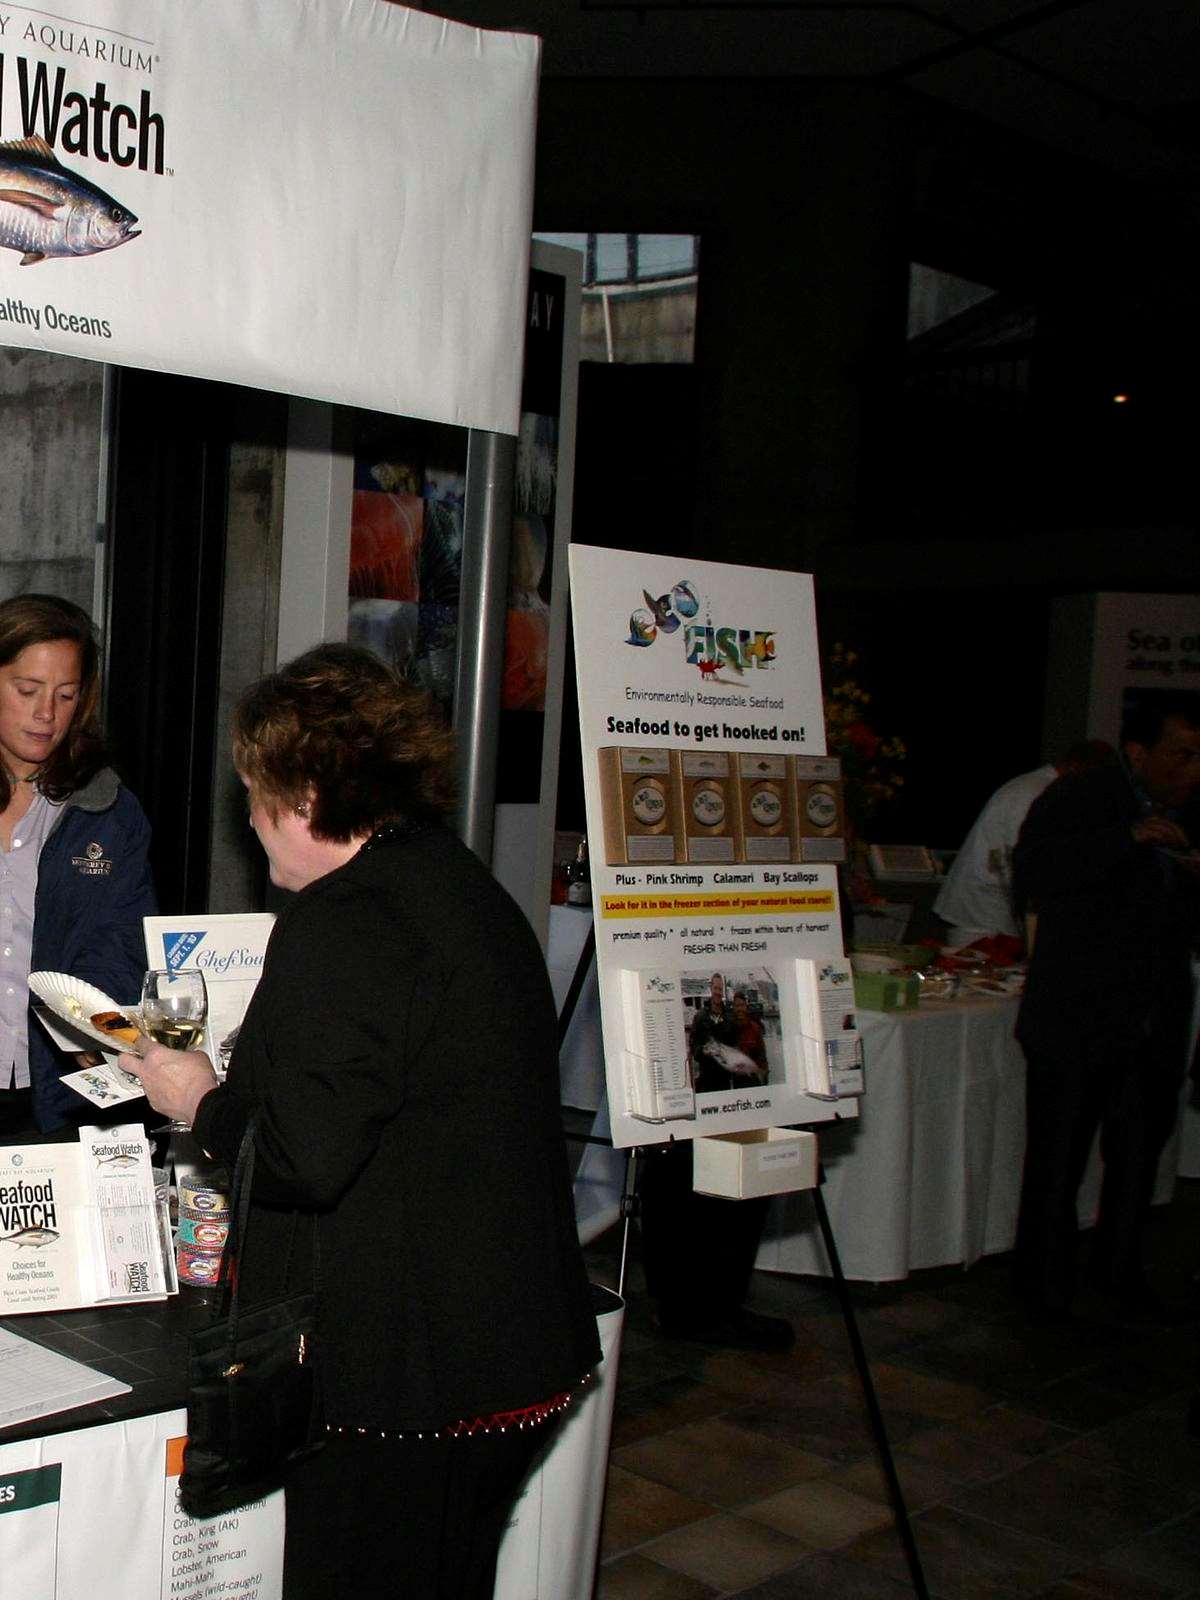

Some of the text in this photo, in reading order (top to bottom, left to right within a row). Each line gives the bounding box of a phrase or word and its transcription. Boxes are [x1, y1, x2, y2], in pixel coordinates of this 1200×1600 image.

[17, 57, 165, 175] Watch
[46, 304, 112, 339] Oceans
[625, 687, 785, 710] Environmentally Responsible Seafood
[607, 716, 805, 742] Seafood to get hooked on!
[616, 872, 819, 887] Plus Pink Shrimp Calamari Bay Scallops
[605, 901, 626, 910] Look
[627, 900, 639, 910] for
[641, 900, 648, 909] it
[649, 900, 657, 909] in
[659, 900, 672, 909] the
[673, 899, 701, 908] freezer
[612, 930, 641, 942] premium
[644, 928, 667, 941] quality
[683, 944, 716, 955] FRESHER
[718, 943, 739, 953] THAN
[701, 1098, 772, 1115] www.ecofish.com
[91, 1143, 143, 1156] Seafood Watch
[129, 1261, 141, 1292] WATCH
[140, 1261, 151, 1291] Seafood
[172, 1518, 239, 1545] Crab, King (AK)
[172, 1540, 219, 1561] Crab, Snow
[205, 1549, 247, 1566] American
[170, 1569, 215, 1593] Mahi-Mahi
[204, 1572, 263, 1596] (wild-caught)
